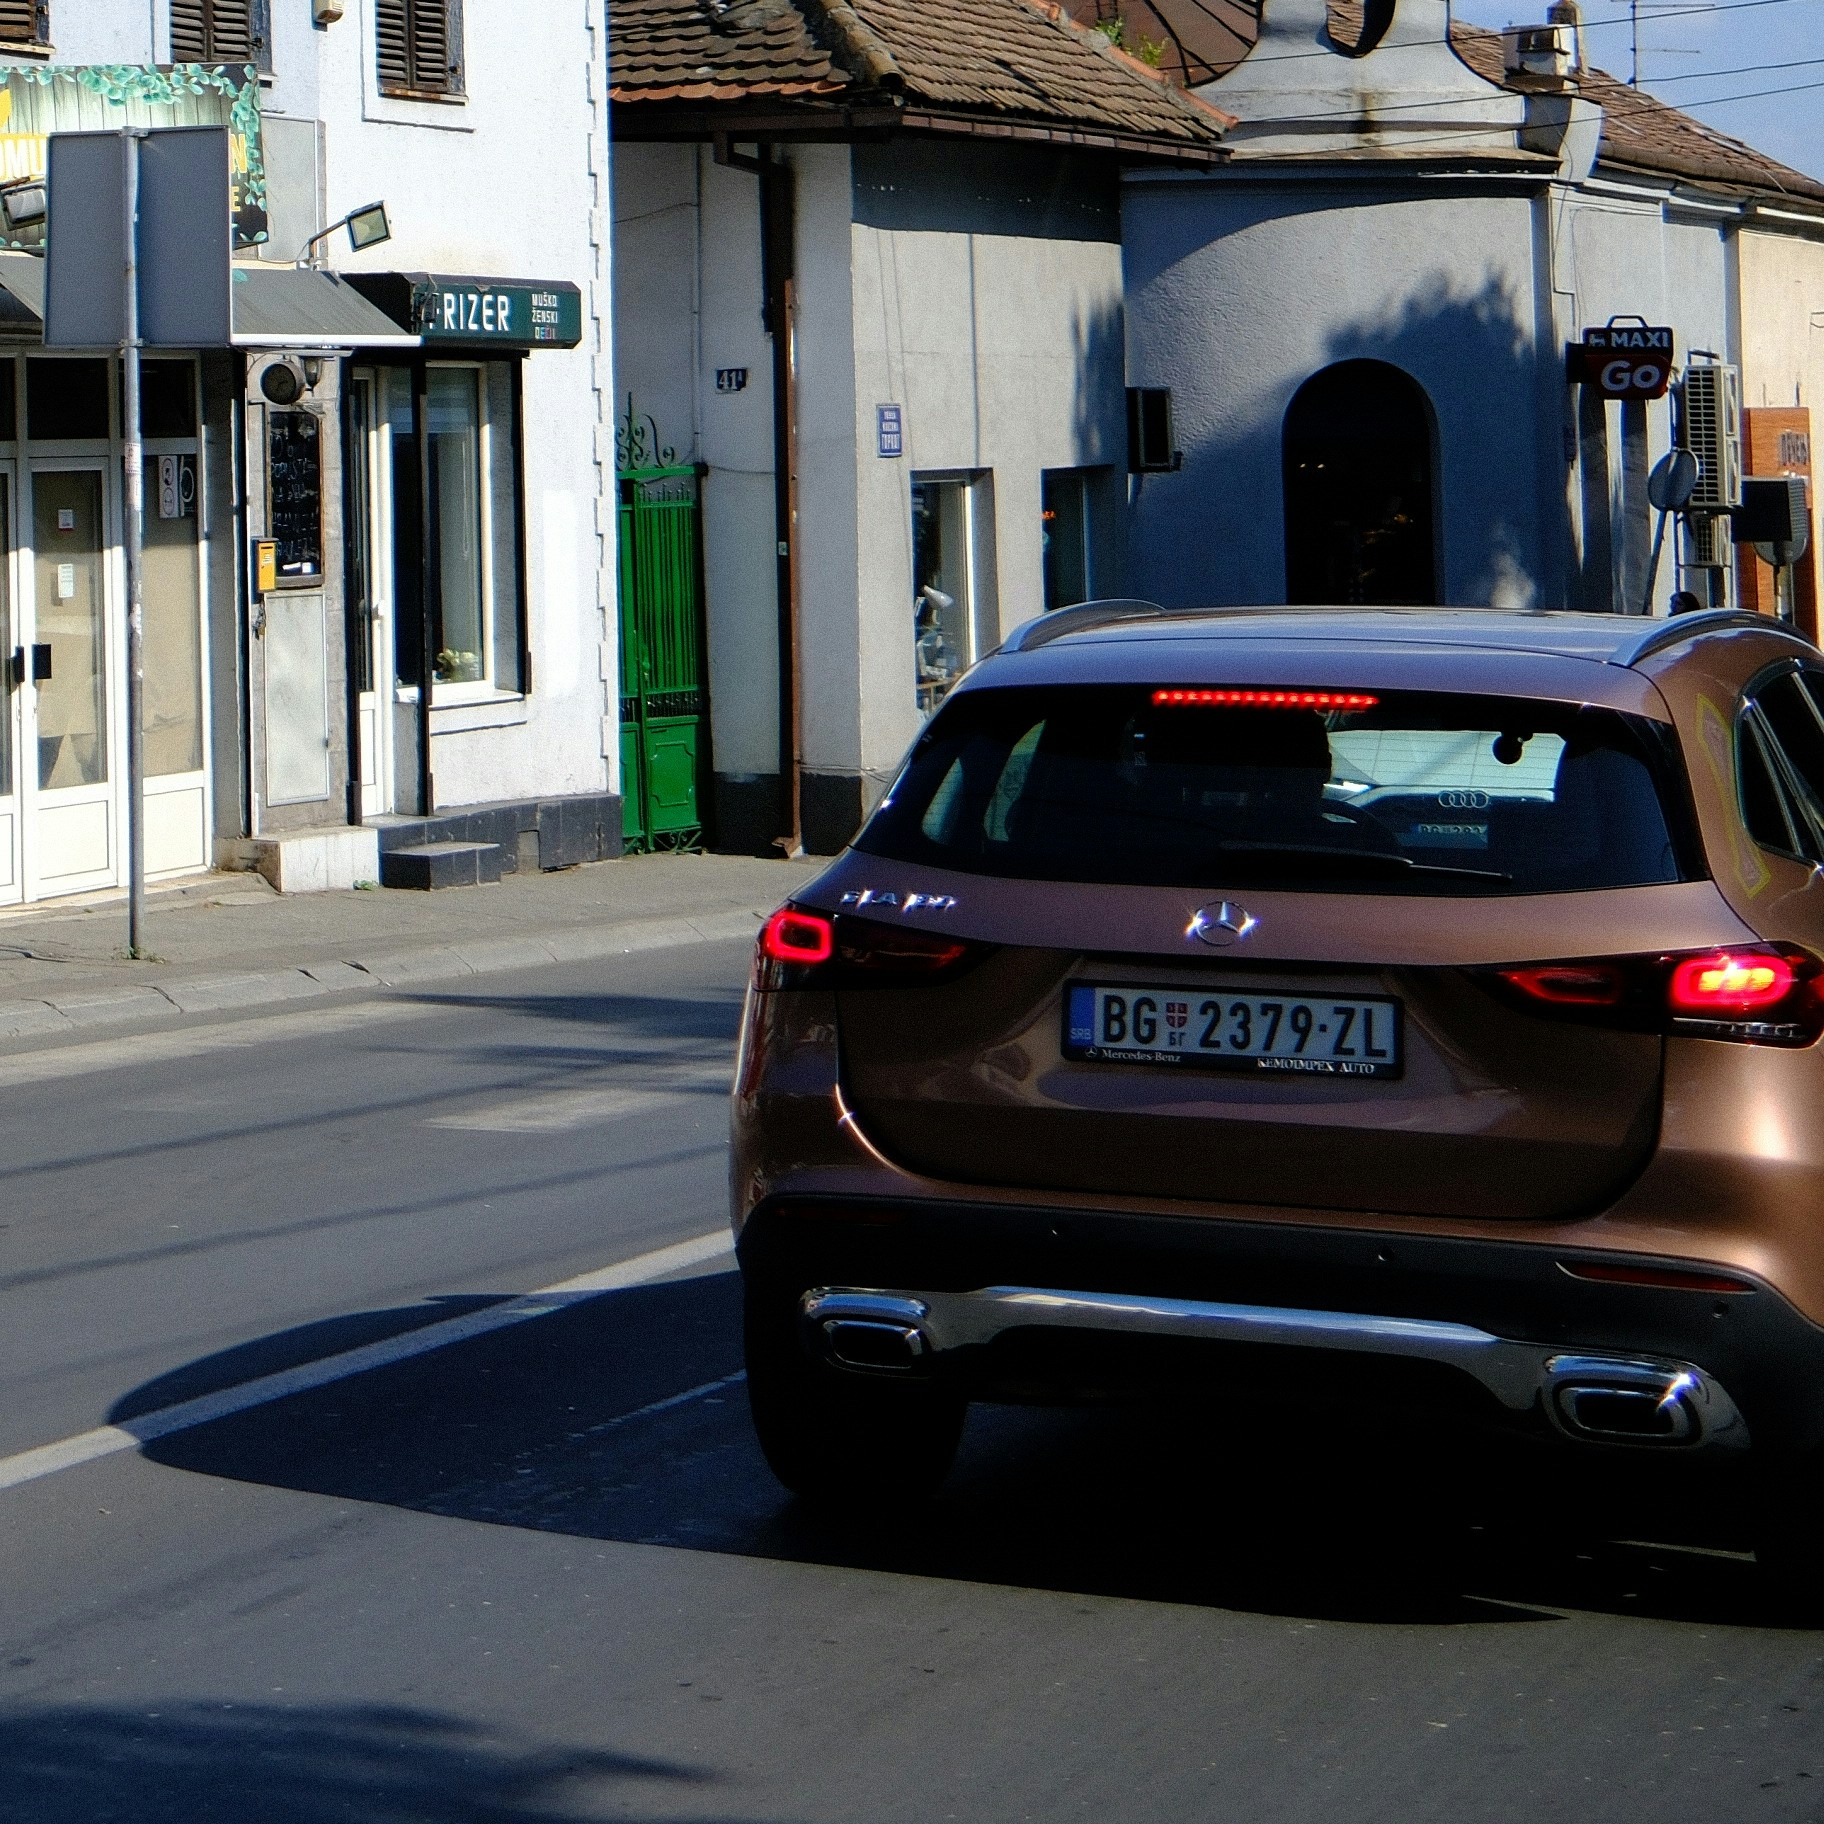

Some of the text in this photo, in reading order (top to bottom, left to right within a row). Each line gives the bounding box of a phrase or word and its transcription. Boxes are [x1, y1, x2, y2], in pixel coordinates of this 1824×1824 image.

[429, 293, 510, 331] RIZER
[532, 307, 558, 324] ŽENSKI
[1610, 331, 1670, 348] MAXI
[1103, 994, 1157, 1045] BG
[1070, 1028, 1092, 1040] SRB
[1102, 1048, 1182, 1063] Mercedes-Benz
[1256, 1057, 1376, 1075] KEMOIMPEX AUTO
